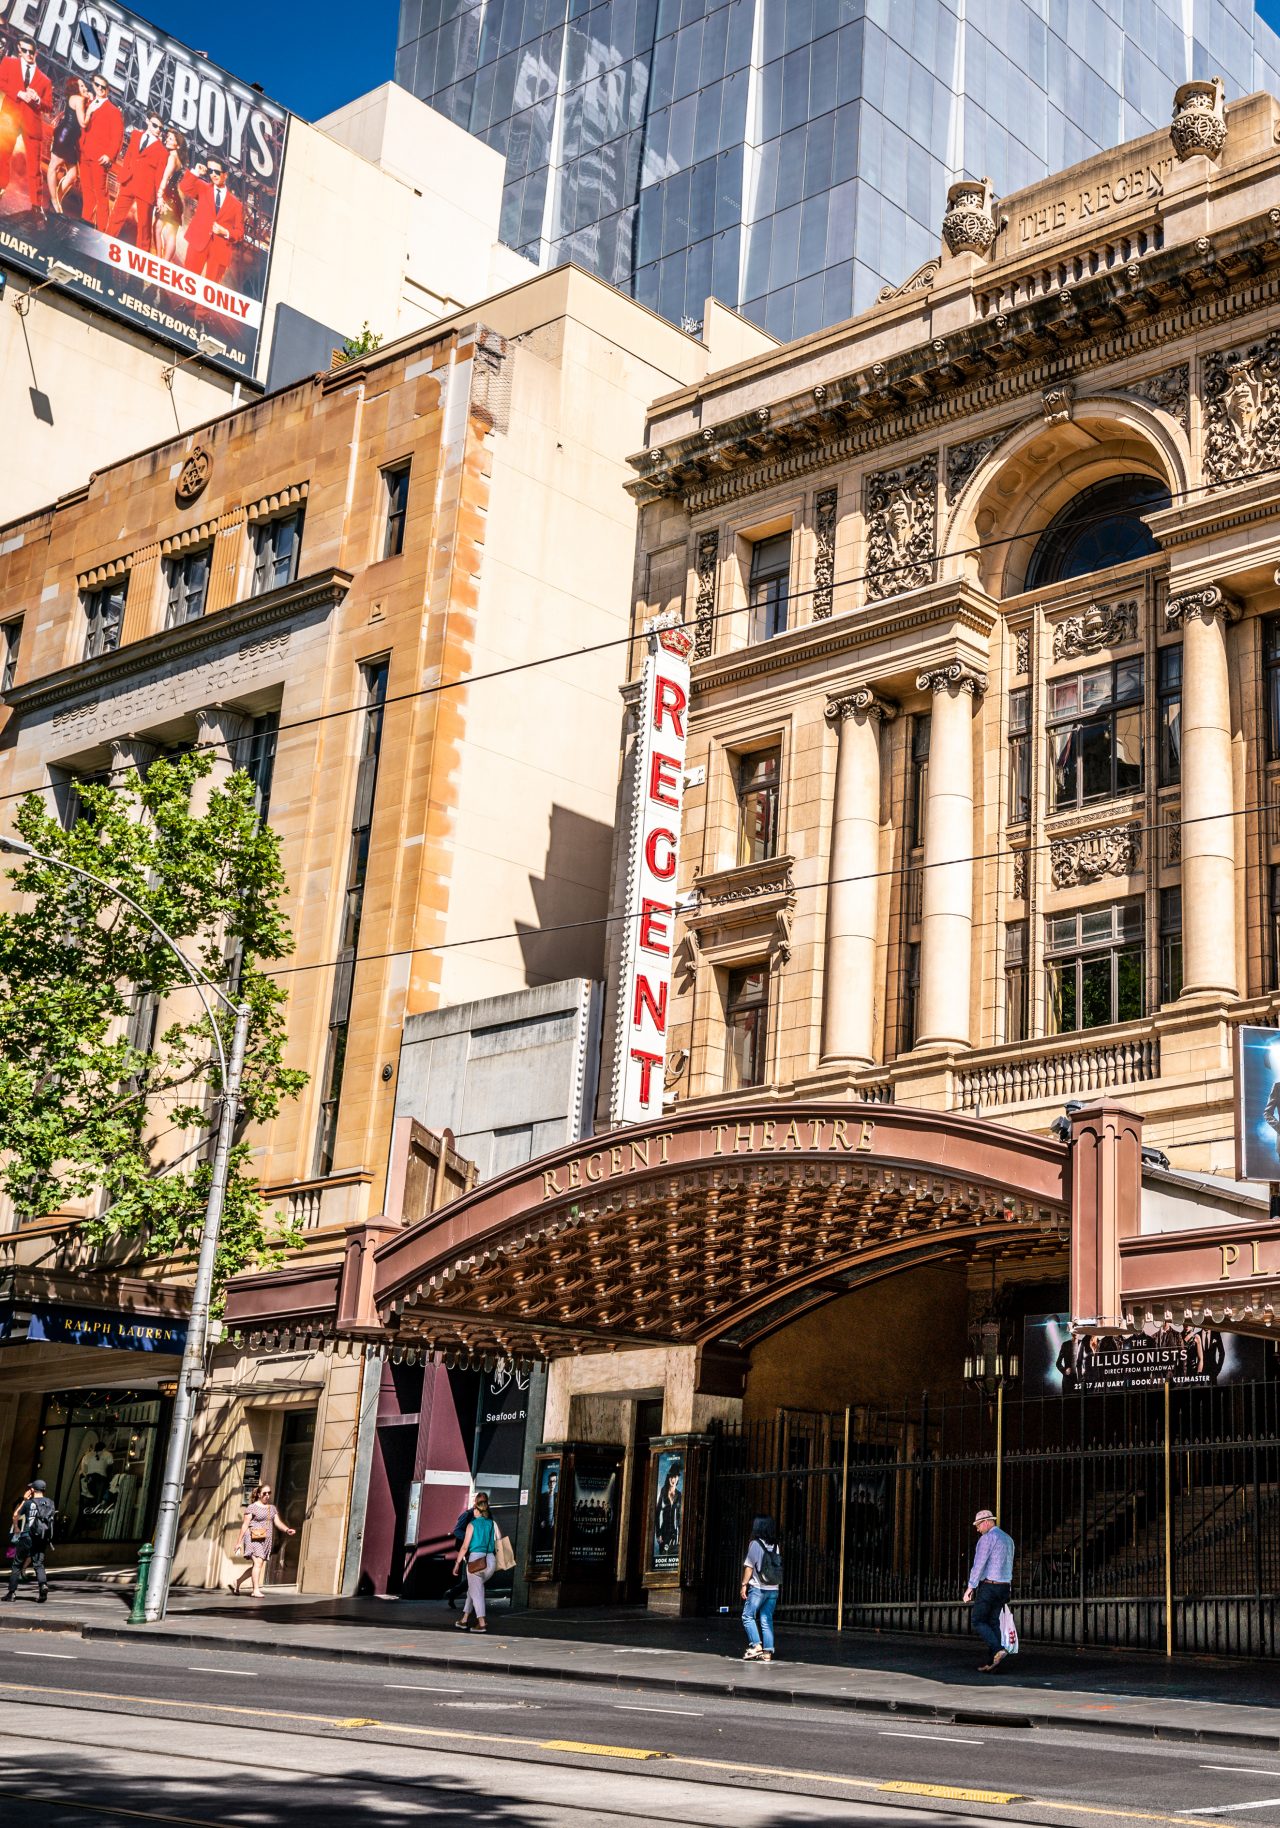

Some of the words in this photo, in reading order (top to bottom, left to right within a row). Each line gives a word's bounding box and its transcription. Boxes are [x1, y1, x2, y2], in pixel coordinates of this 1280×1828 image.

[0, 0, 166, 108] ERSEY
[171, 62, 273, 178] BOYS
[1019, 201, 1067, 243] THE
[0, 231, 38, 260] UARY
[73, 268, 104, 294] PRIL
[118, 293, 246, 365] JERSEYBOYS..AU
[108, 243, 121, 263] 8
[127, 249, 197, 296] WEEKS
[203, 284, 251, 319] ONLY
[51, 686, 188, 748] THEOSOPHICAL
[203, 648, 291, 696] SOCIETY
[109, 650, 227, 706] MELBOURNE
[631, 673, 687, 1109] REGENT
[542, 1132, 673, 1200] REGENT
[710, 1118, 876, 1155] THEATRE
[64, 1319, 111, 1334] RALPH
[118, 1323, 173, 1341] LAUREN
[1091, 1350, 1188, 1367] ILLUSIONISTS
[1131, 1378, 1151, 1386] BOOK
[1143, 1364, 1176, 1372] BROADWAY
[486, 1411, 517, 1422] Seafood
[83, 1502, 115, 1515] Sale
